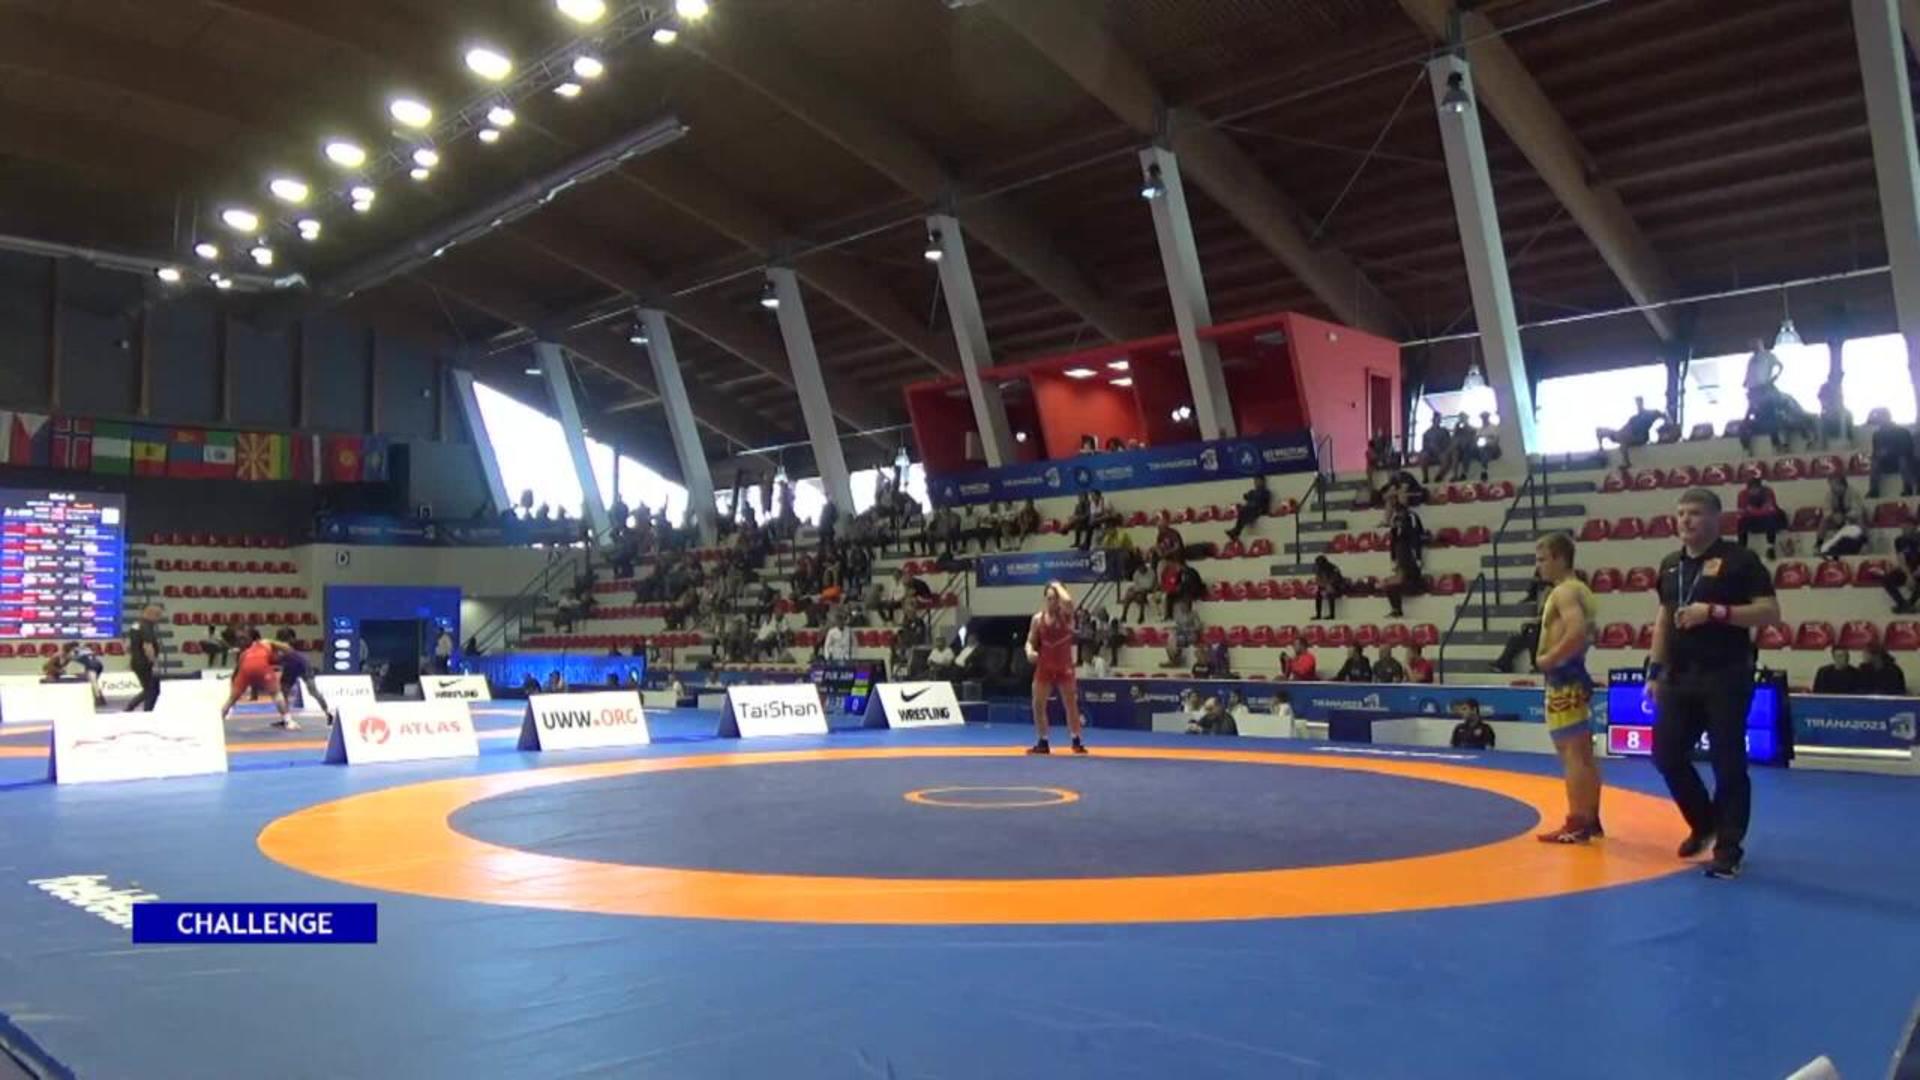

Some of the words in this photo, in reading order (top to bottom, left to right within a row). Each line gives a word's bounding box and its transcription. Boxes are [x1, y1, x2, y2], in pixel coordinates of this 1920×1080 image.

[738, 700, 818, 719] TaiShan
[898, 706, 950, 722] WRESTLING
[400, 720, 461, 735] ATLAS
[541, 709, 638, 730] UWW.ORG
[1626, 730, 1640, 749] 8
